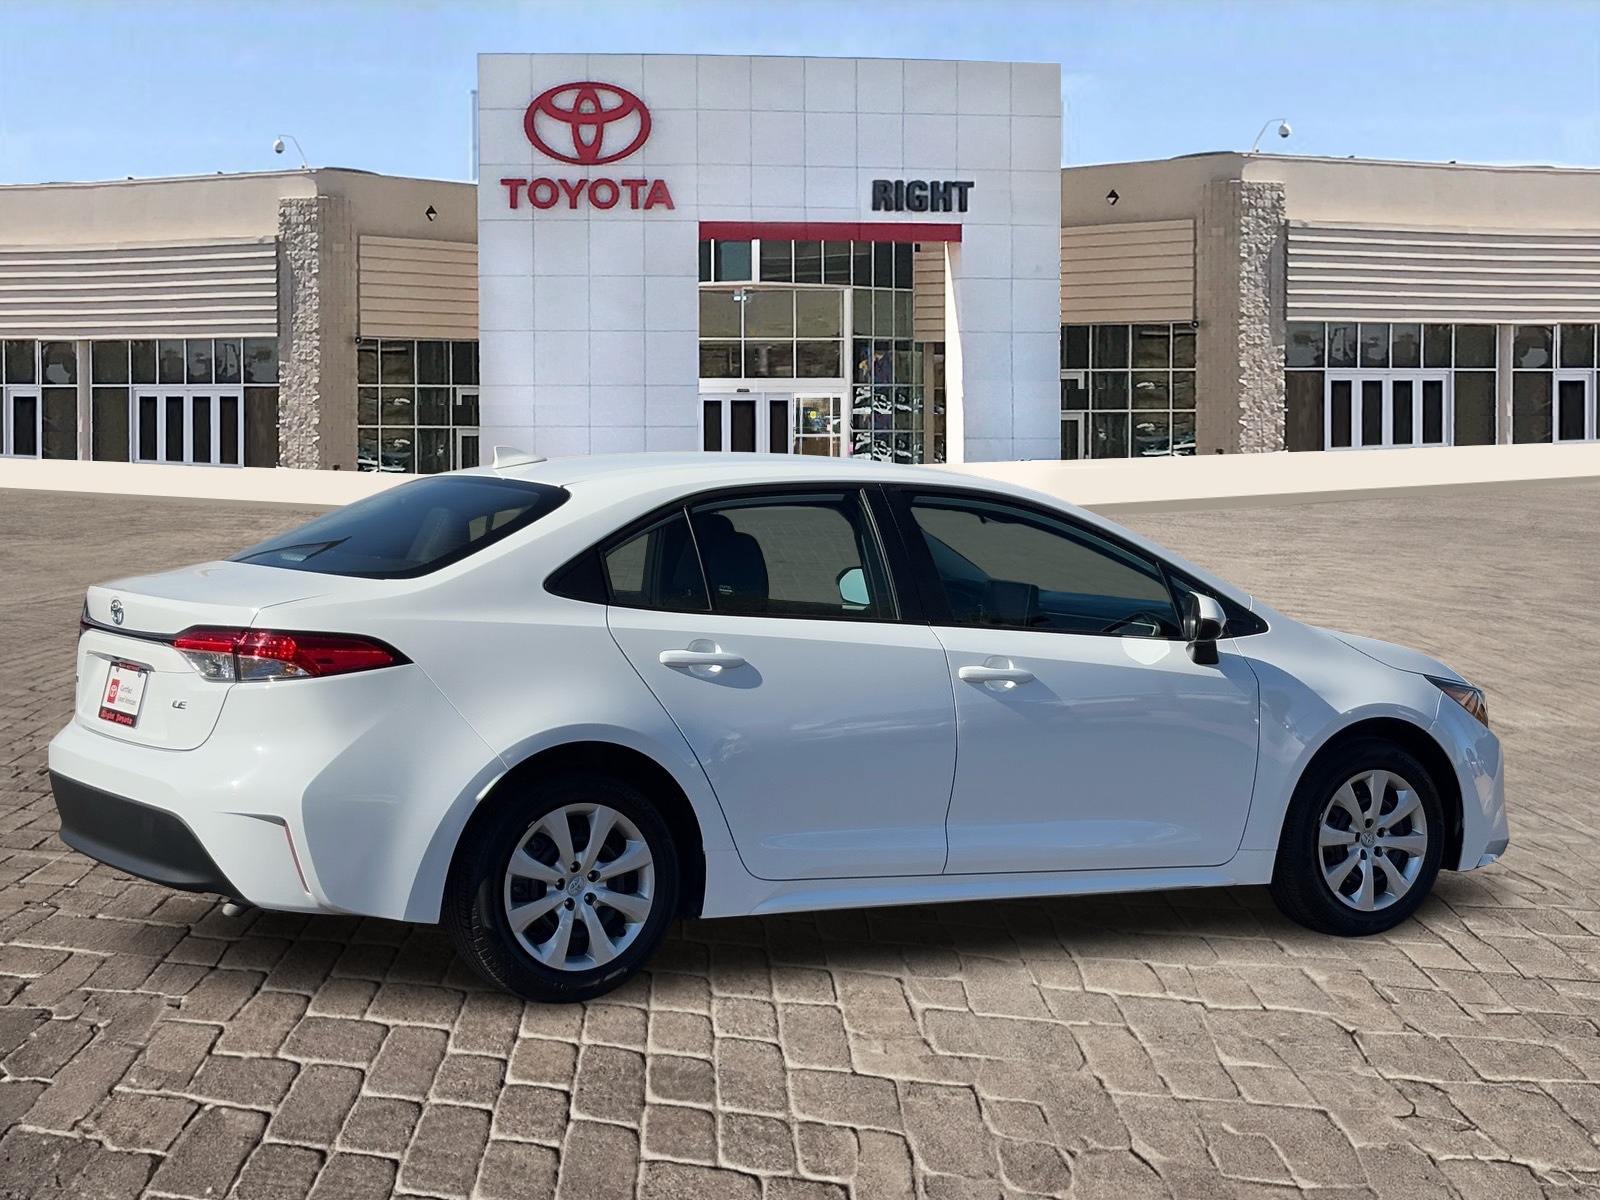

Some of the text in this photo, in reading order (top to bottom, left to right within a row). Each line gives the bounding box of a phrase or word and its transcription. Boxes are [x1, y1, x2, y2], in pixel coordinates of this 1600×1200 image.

[500, 178, 675, 210] TOYOTA
[872, 180, 975, 212] RIGHT
[172, 700, 187, 710] LE
